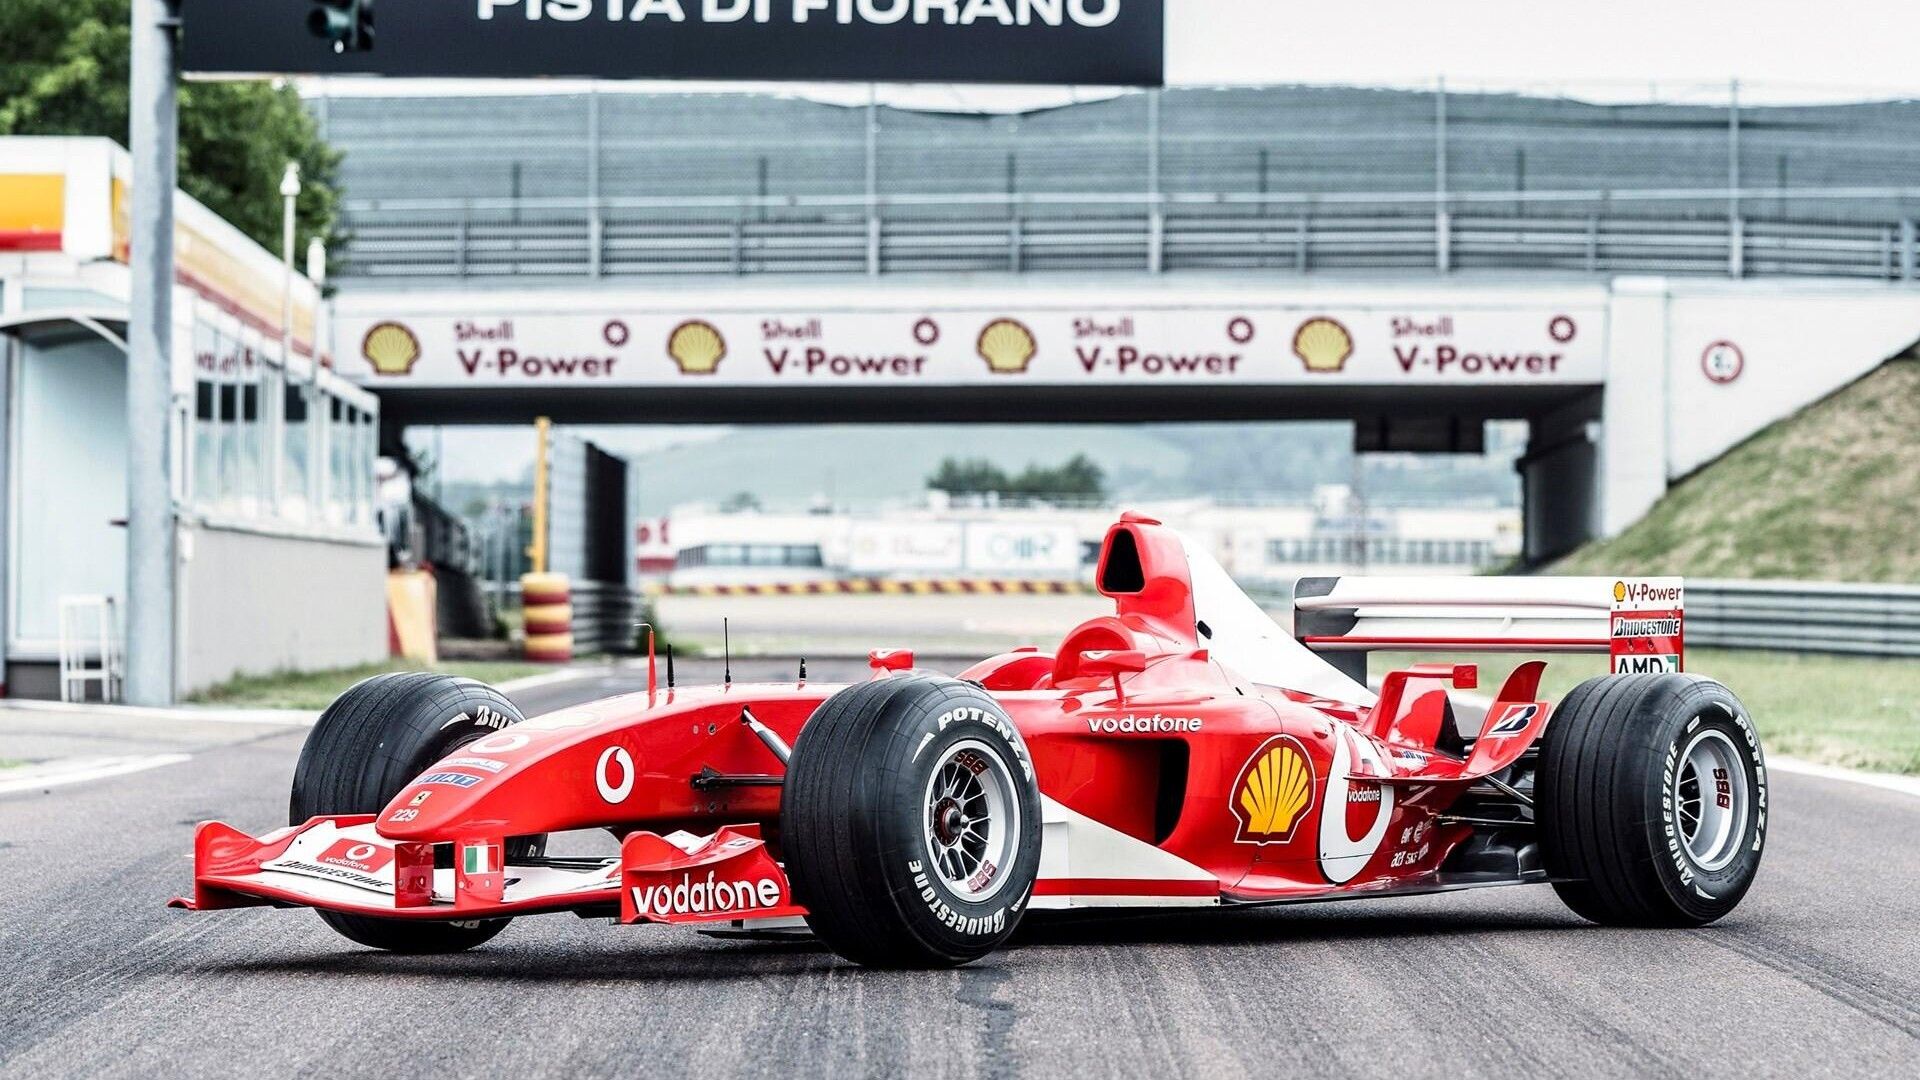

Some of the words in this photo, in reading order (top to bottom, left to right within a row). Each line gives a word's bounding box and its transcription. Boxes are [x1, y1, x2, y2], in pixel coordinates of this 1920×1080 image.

[477, 0, 687, 22] PISTA
[702, 0, 771, 24] DI
[792, 0, 1121, 28] FIORANO
[456, 348, 618, 377] V-Power
[763, 347, 928, 375] V-Power
[1075, 346, 1243, 374] V-Power
[1393, 345, 1563, 373] V-Power
[1627, 583, 1682, 602] V-Power
[1614, 619, 1680, 636] BRIDGESTONE
[1618, 657, 1663, 674] AMD
[1087, 713, 1203, 733] vodafone
[938, 706, 1033, 782] POTENZA
[1348, 786, 1381, 803] vodafone
[1713, 767, 1732, 810] BBS
[1734, 713, 1766, 852] POTENZA
[387, 808, 420, 822] 229
[1662, 740, 1695, 887] BRIDGESTONE
[325, 856, 371, 871] vodafone
[631, 872, 780, 915] vodafone
[908, 859, 1007, 936] BRIDGESTONE
